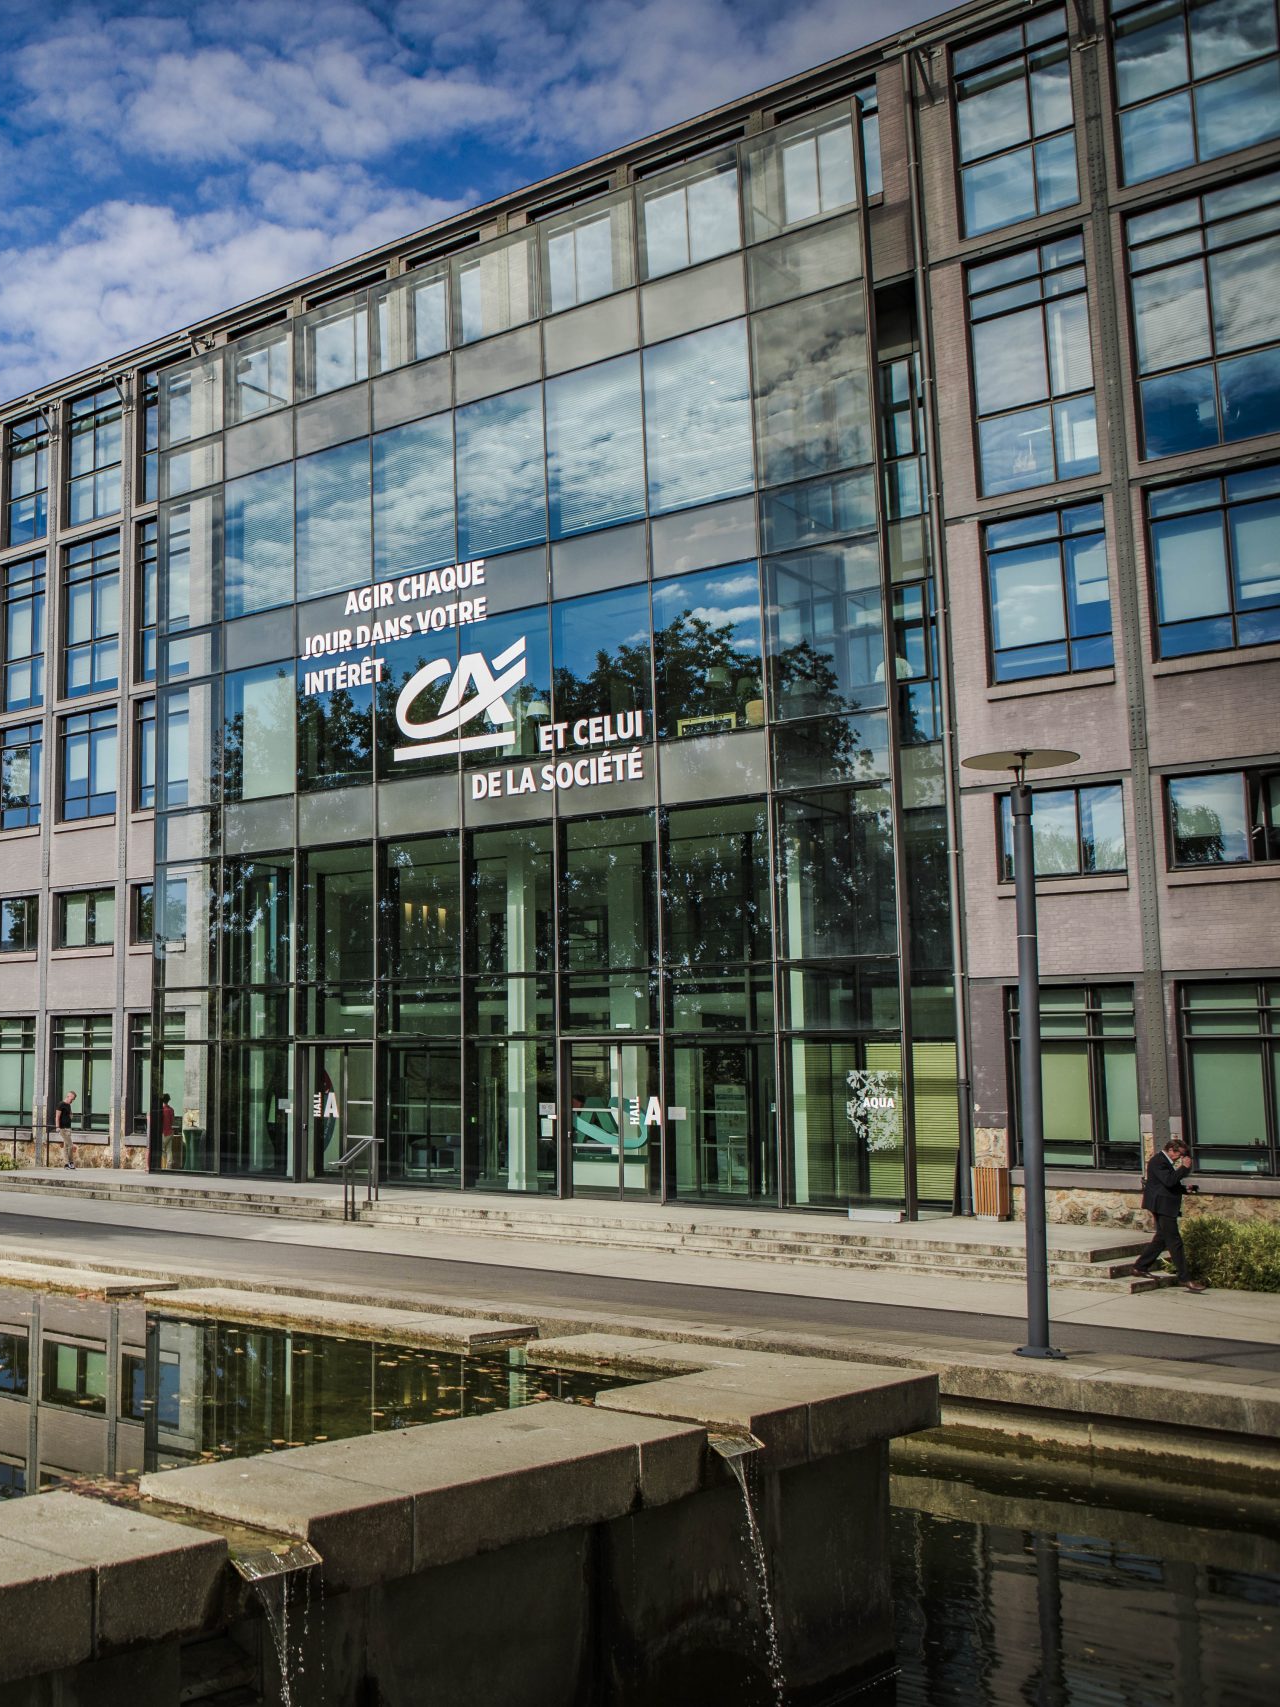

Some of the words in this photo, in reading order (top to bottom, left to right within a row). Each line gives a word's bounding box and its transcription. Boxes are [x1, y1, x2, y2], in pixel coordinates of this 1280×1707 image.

[344, 584, 394, 616] AGIR
[398, 559, 486, 602] CHAQUE
[301, 629, 352, 661] JOUR
[356, 615, 413, 649] DANS
[416, 596, 488, 635] VOTRE
[304, 656, 385, 696] INTÉRÊT
[539, 721, 568, 752] ET
[573, 710, 643, 746] CELUI
[471, 770, 501, 800] DE
[506, 766, 537, 796] LA
[541, 746, 644, 791] SOCIÉTÉ
[313, 1091, 322, 1118] HALL
[323, 1092, 340, 1118] A
[629, 1096, 640, 1125] HALL
[643, 1096, 662, 1126] A
[862, 1097, 896, 1109] AQUA
